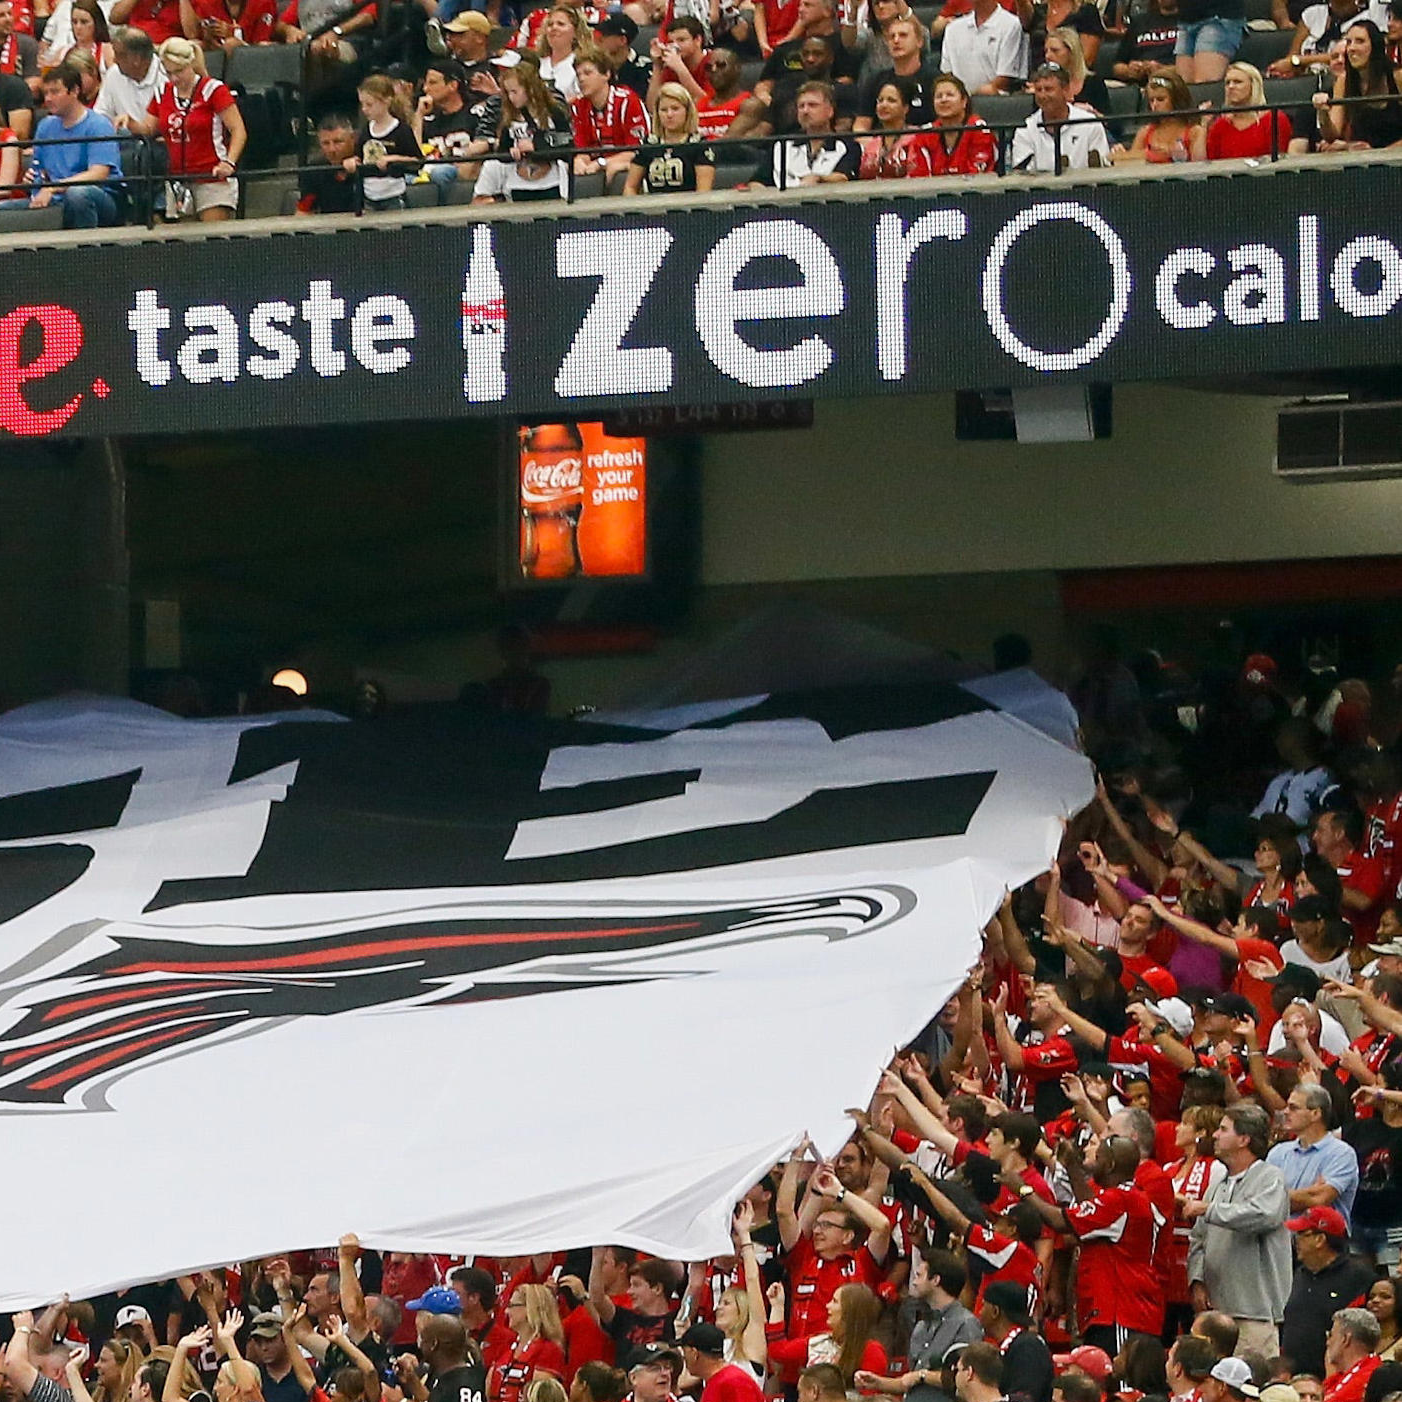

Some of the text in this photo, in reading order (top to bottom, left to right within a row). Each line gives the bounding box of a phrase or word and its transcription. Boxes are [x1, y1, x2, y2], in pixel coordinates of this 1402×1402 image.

[553, 201, 1133, 398] zero
[126, 279, 417, 387] taste
[586, 449, 644, 468] refresh
[596, 468, 634, 487] your
[591, 485, 639, 505] game
